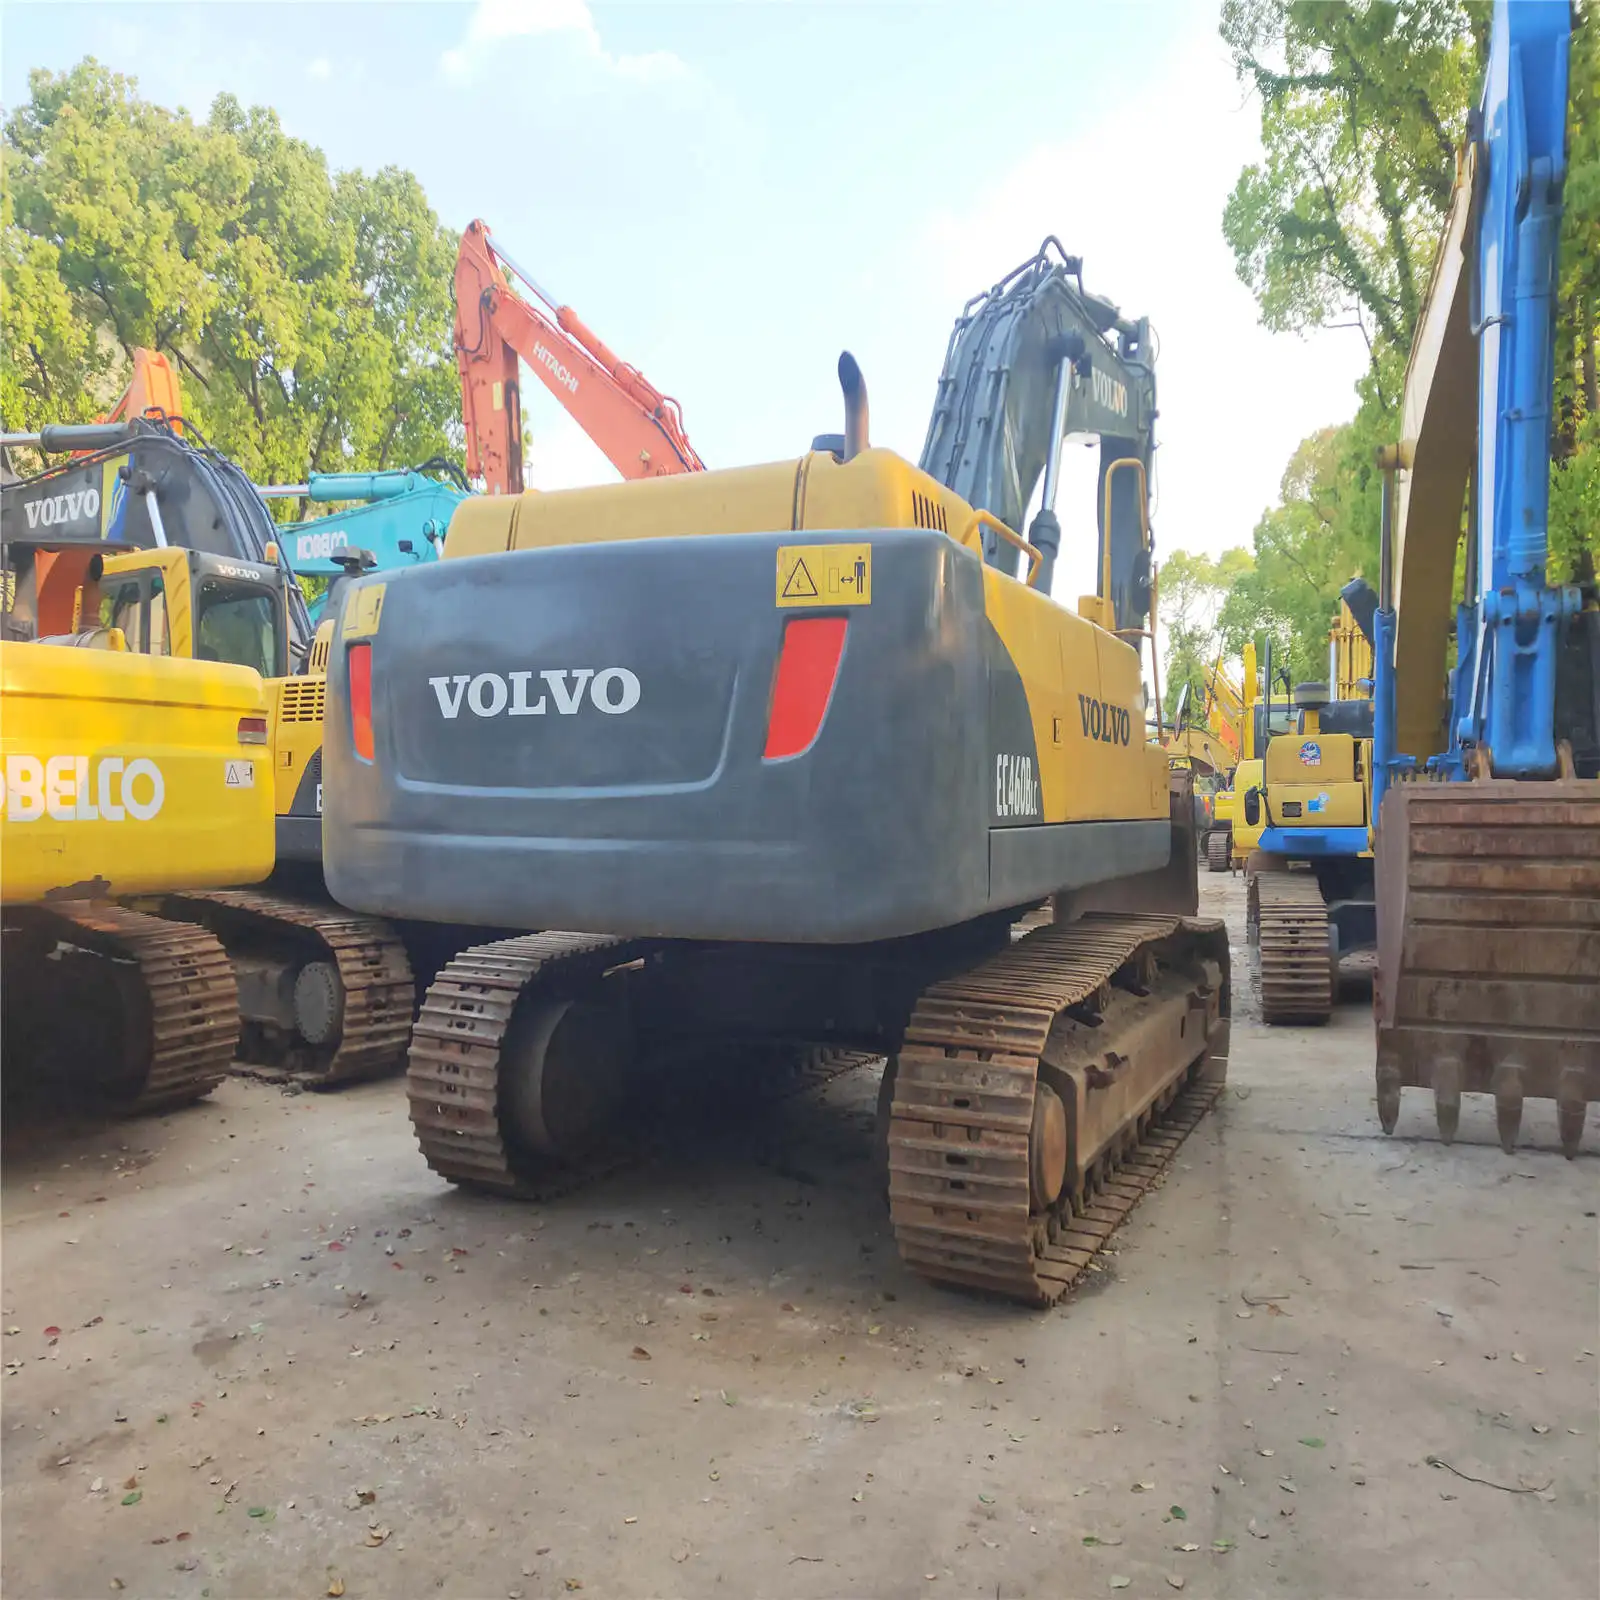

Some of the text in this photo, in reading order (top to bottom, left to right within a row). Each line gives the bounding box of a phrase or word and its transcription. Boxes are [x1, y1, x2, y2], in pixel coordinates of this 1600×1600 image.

[533, 341, 579, 394] HITACHI
[1091, 366, 1128, 418] VOLVO
[24, 488, 100, 529] VOLVO
[217, 564, 260, 580] VOLVO
[428, 667, 641, 719] VOLVO
[1078, 693, 1130, 747] VOLVO
